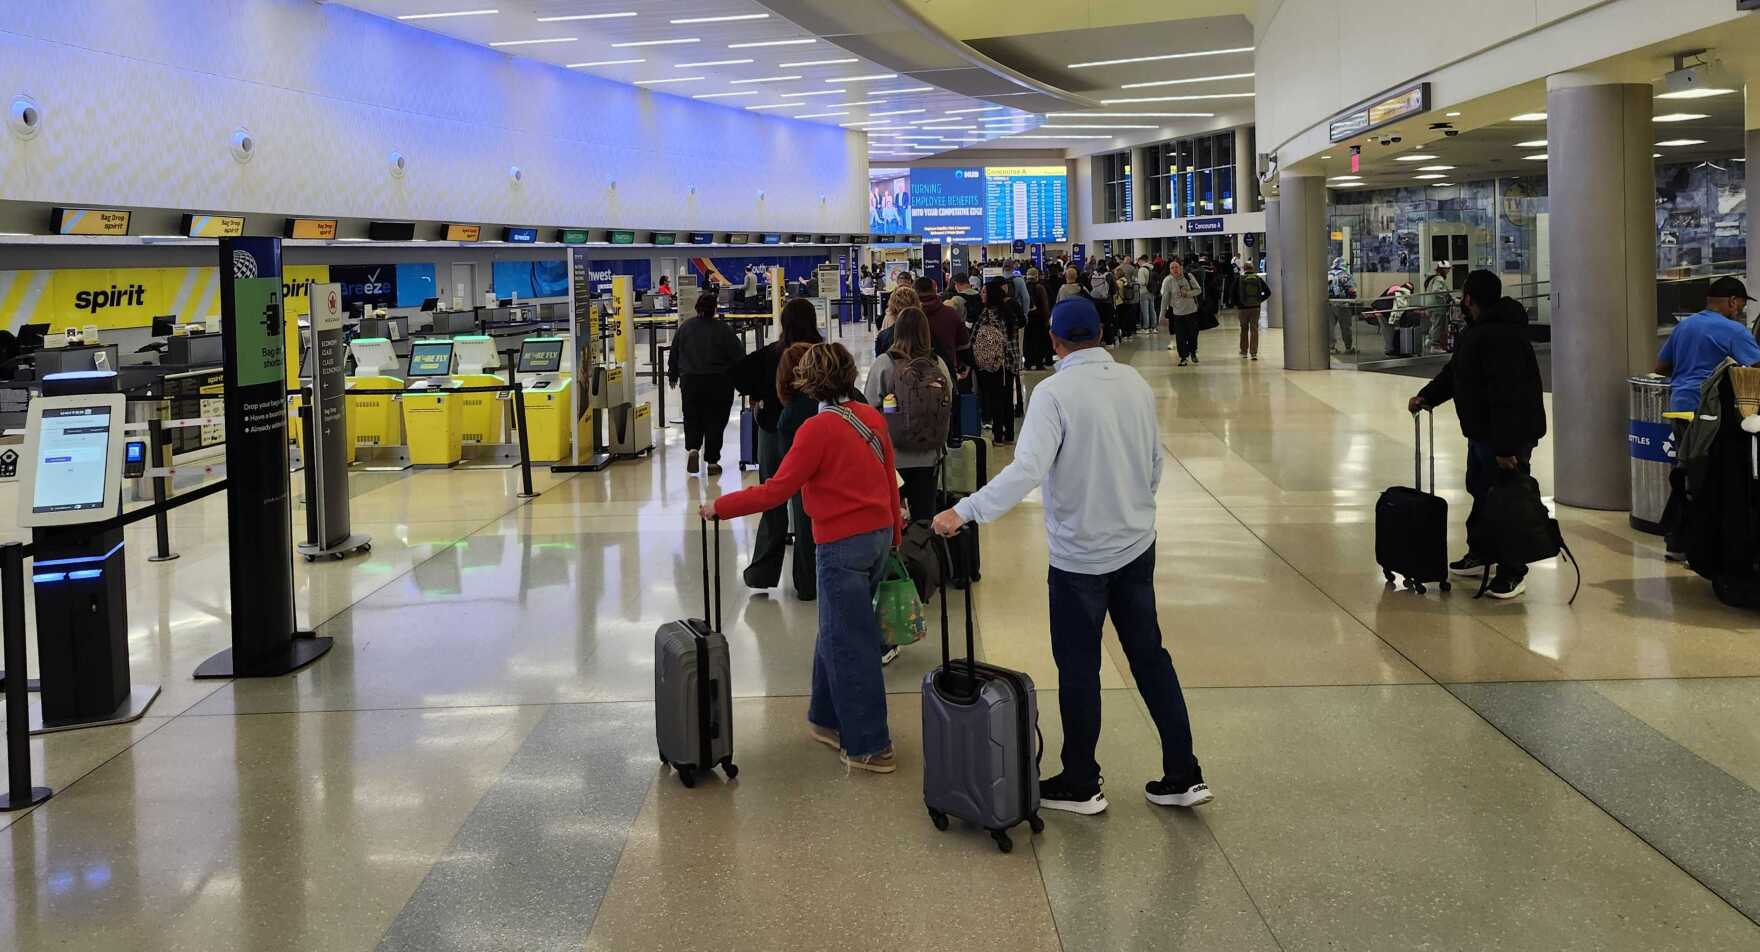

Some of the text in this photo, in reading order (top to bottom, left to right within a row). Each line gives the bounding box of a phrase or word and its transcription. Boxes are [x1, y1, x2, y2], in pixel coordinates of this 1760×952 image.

[912, 184, 942, 194] TURNING
[912, 194, 979, 206] EMPLOYEE BENEFITS
[924, 208, 938, 216] YOUR
[939, 208, 969, 216] COMPETITIVE
[101, 214, 124, 222] Bag Drop
[105, 223, 123, 231] spirit
[283, 278, 316, 298] piri
[75, 284, 146, 314] spirit
[243, 403, 259, 412] Drop
[259, 401, 271, 410] your
